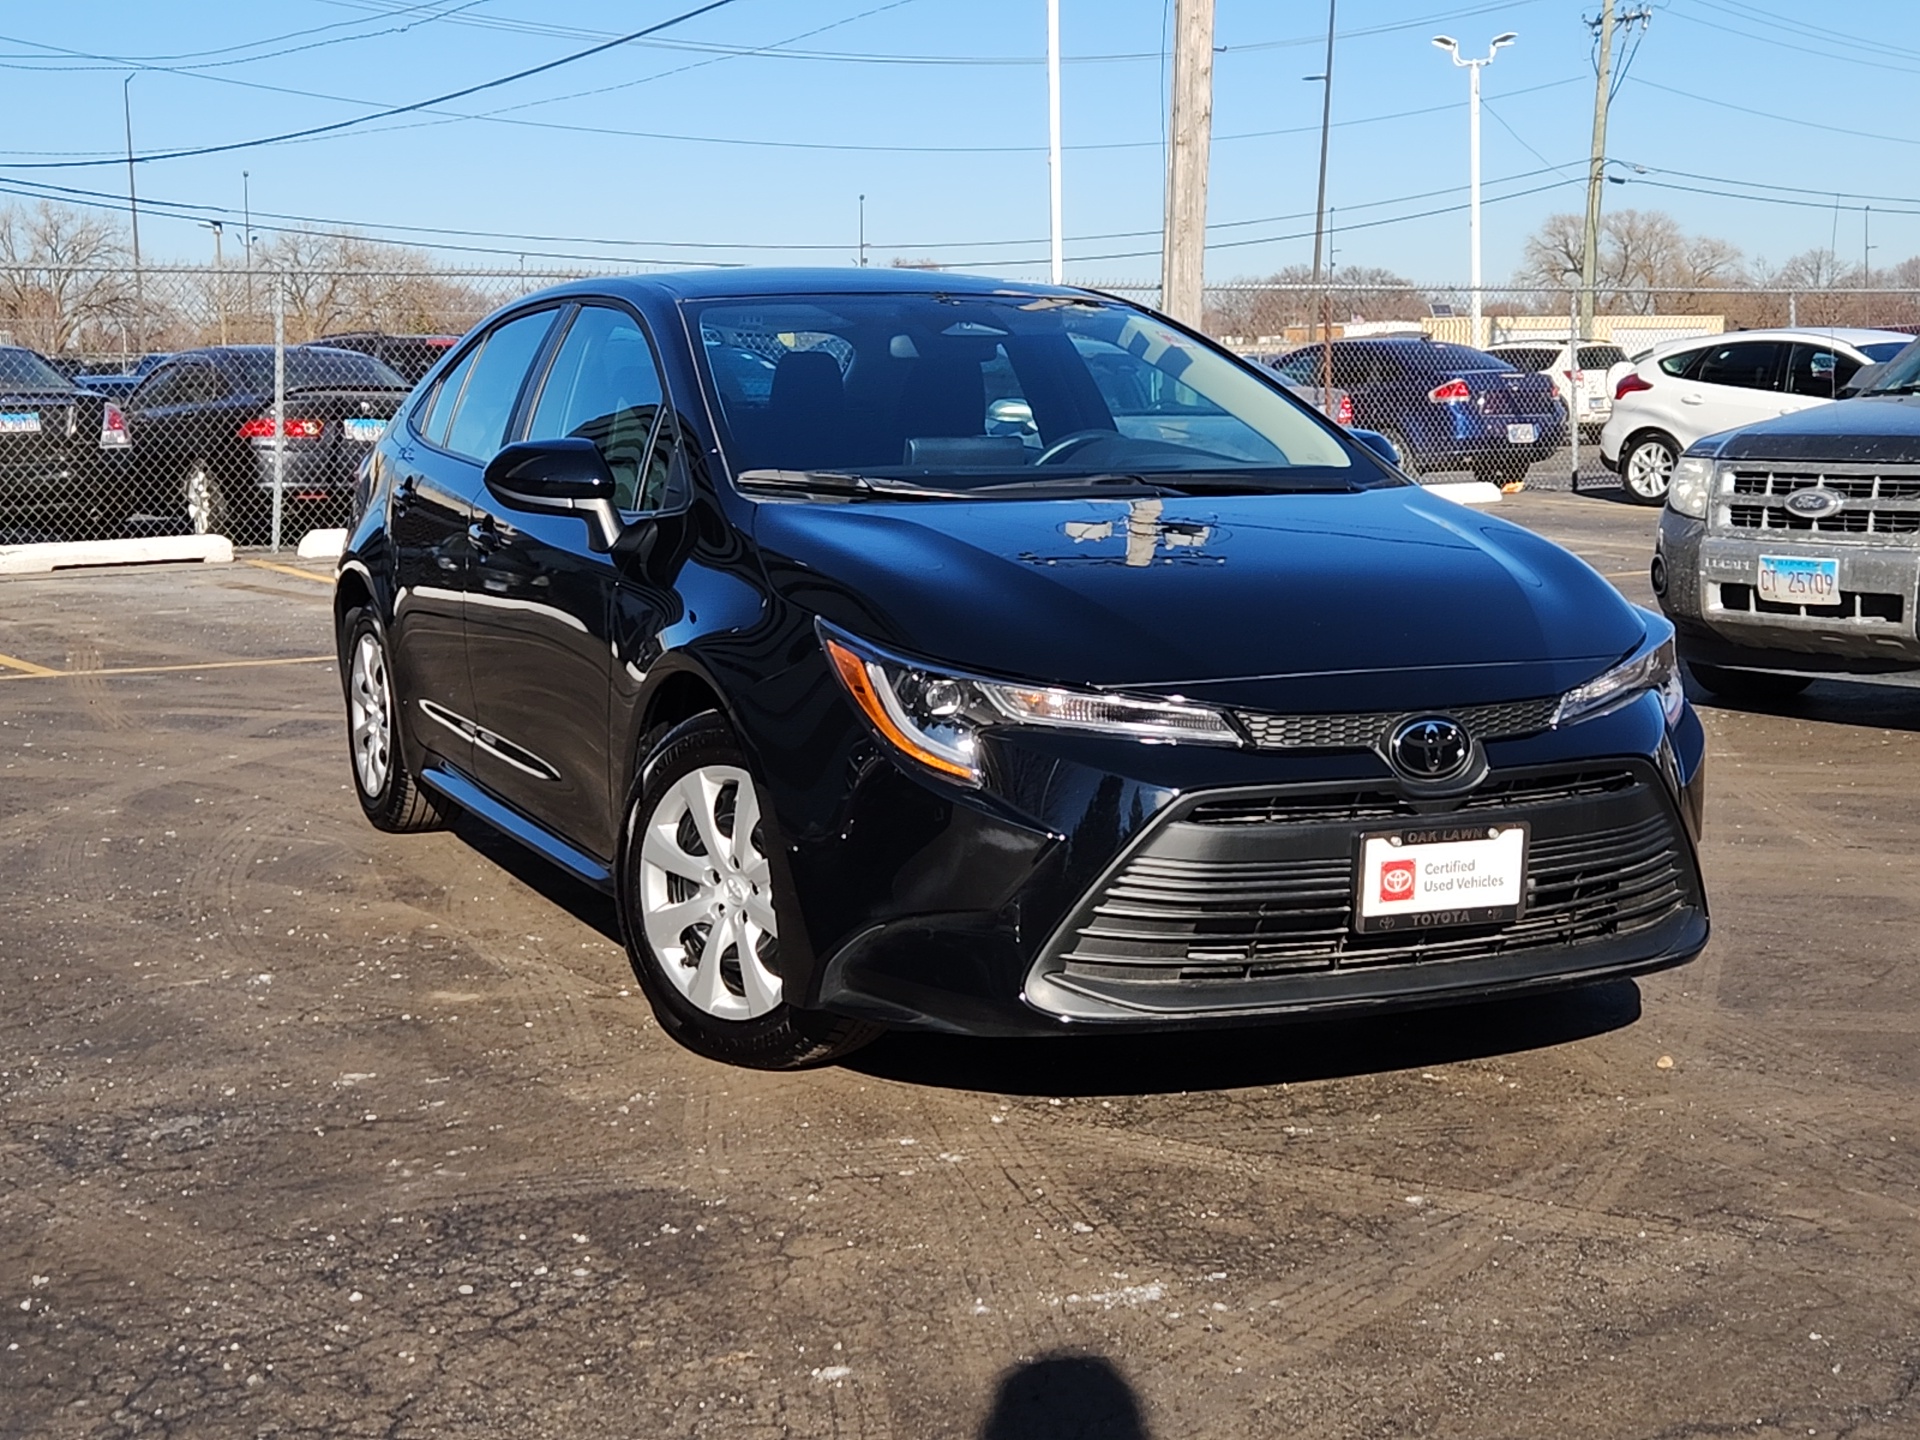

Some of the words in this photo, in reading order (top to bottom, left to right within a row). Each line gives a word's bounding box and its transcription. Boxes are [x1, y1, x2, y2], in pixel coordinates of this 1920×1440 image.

[1761, 569, 1777, 592] CT
[1788, 571, 1833, 596] 25709
[1407, 831, 1437, 844] OAK
[1442, 827, 1483, 841] LAWN
[1424, 859, 1475, 875] Certified
[1423, 878, 1454, 892] Used
[1456, 874, 1505, 890] Vehicles
[1411, 910, 1470, 926] TOYOTA
